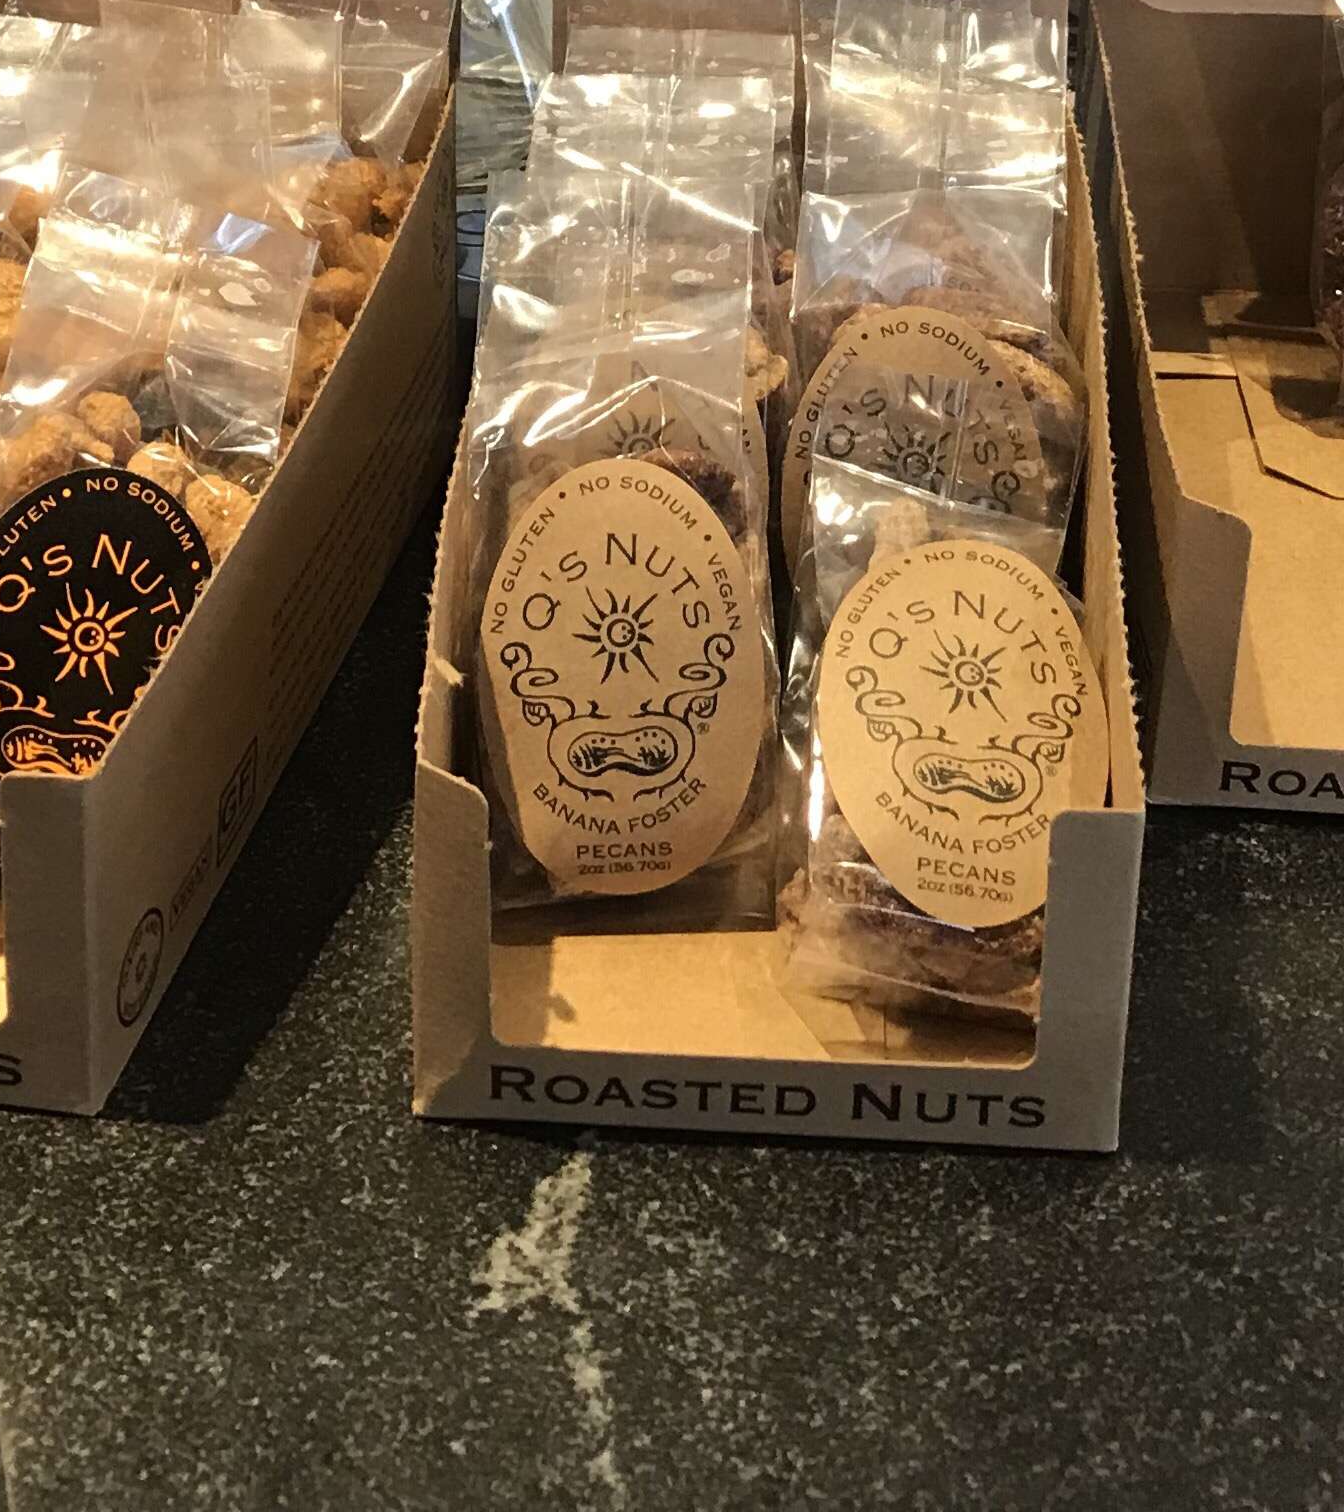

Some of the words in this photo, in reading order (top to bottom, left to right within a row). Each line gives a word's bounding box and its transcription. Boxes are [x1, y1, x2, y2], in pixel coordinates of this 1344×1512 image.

[795, 429, 813, 461] NO
[880, 321, 910, 339] NO
[917, 322, 992, 377] SODIUM
[86, 476, 120, 493] NO
[127, 480, 196, 553] SODIUM
[490, 600, 509, 635] NO
[503, 505, 556, 593] GLUTEN
[578, 475, 611, 496] NO
[619, 475, 698, 531] SODIUM
[706, 551, 742, 632] VEGAN
[91, 533, 182, 654] NUTS
[521, 549, 589, 632] Q'S
[605, 532, 711, 631] NUTS
[835, 629, 855, 659] NO
[847, 568, 902, 626] GLUTEN
[924, 550, 955, 565] NO
[964, 550, 1046, 602] SODIUM
[1054, 624, 1090, 698] VEGAN
[868, 599, 936, 660] Q'S
[953, 589, 1058, 685] NUTS
[532, 781, 621, 836] BANANA
[627, 775, 708, 834] FOSTER
[874, 791, 965, 856] BANANA
[972, 813, 1052, 856] FOSTER
[576, 840, 674, 859] PECANS
[916, 856, 1017, 887] PECANS
[487, 1063, 819, 1118] ROASTED
[850, 1082, 1049, 1130] NUTS
